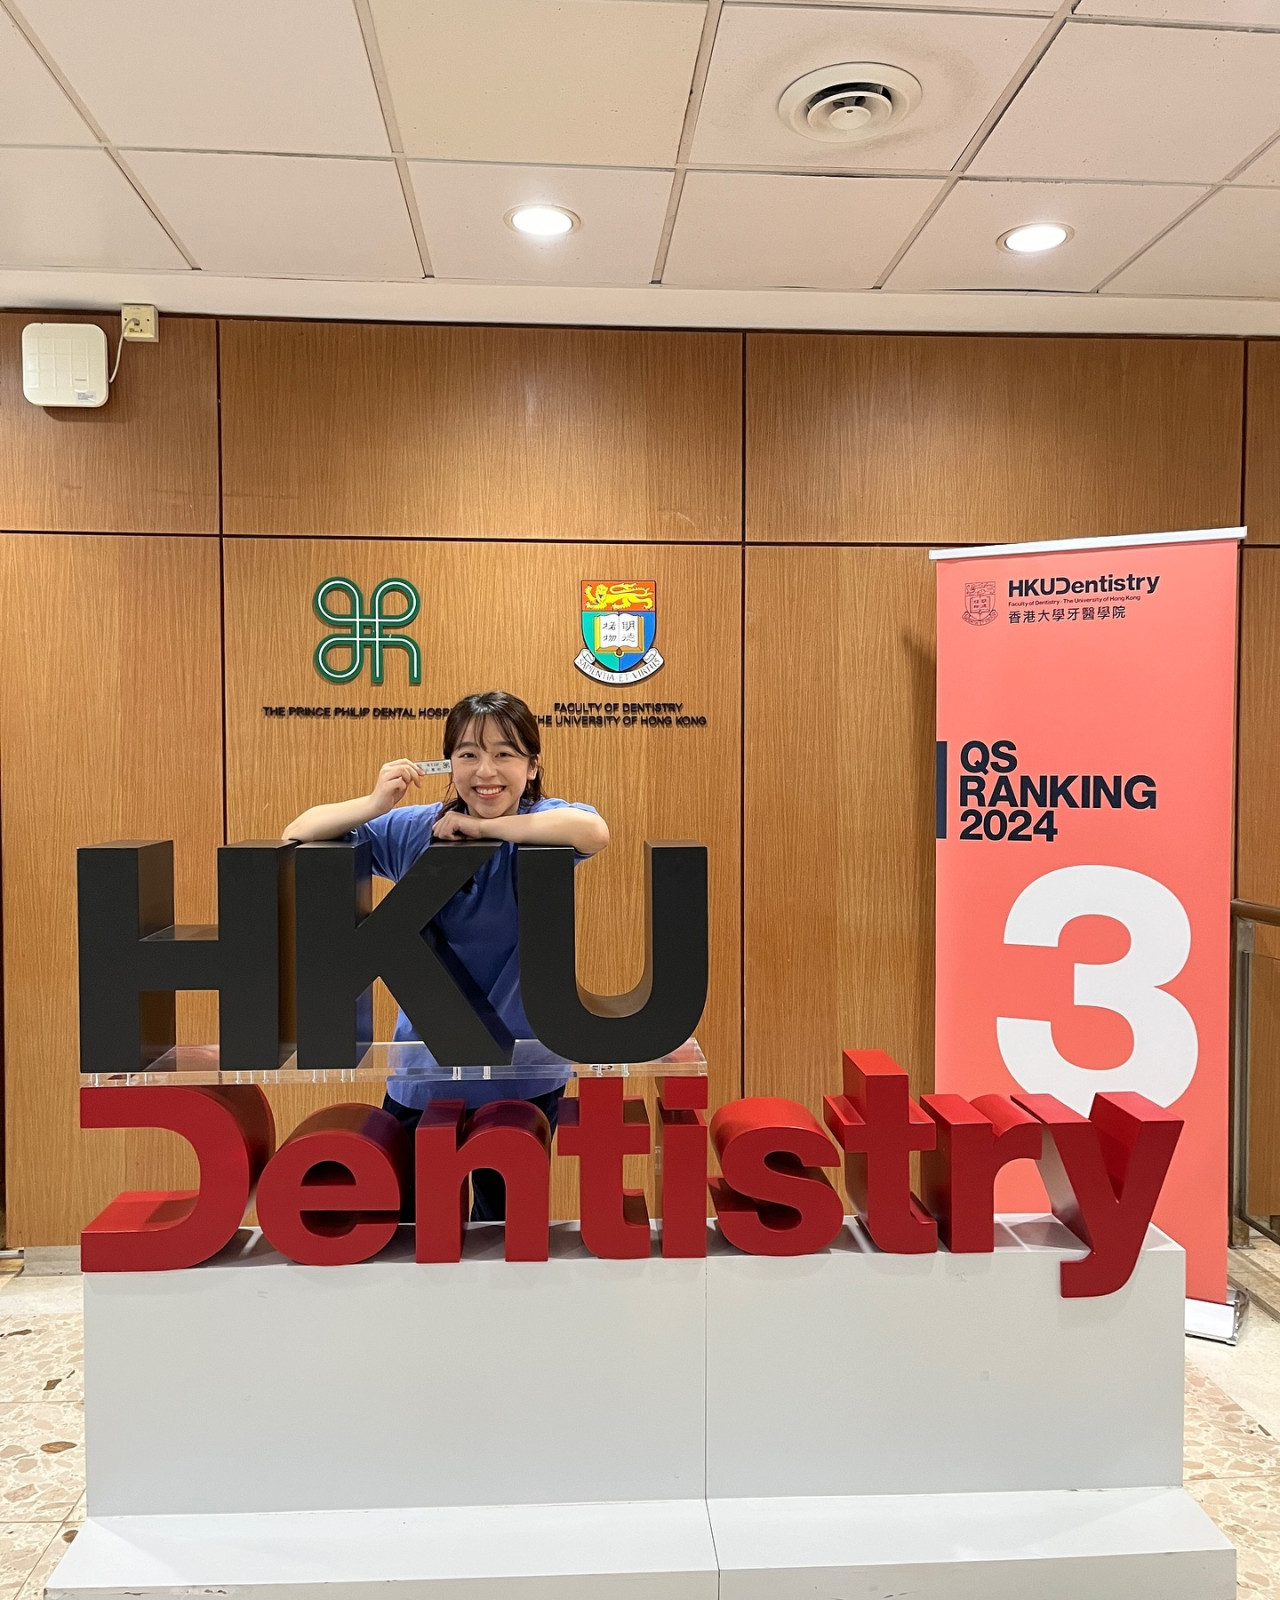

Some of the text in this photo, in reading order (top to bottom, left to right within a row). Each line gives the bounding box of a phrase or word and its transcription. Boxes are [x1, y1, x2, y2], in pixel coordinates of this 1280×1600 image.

[1008, 605, 1126, 624] 香港大學牙醫學院
[262, 706, 286, 718] THE
[288, 706, 331, 718] PRINCE
[334, 707, 370, 718] PHILIP
[373, 707, 416, 718] DENTAL
[554, 702, 683, 714] FACULTY OF DENTISTRY
[556, 715, 621, 727] UNIVERSITY
[622, 715, 637, 727] OF
[641, 715, 672, 727] HONG
[676, 715, 707, 727] KONG
[960, 740, 1018, 775] QS
[959, 775, 1157, 809] RANKING
[959, 809, 1058, 842] 2024
[77, 842, 708, 1073] HKU
[996, 864, 1199, 1119] 3
[79, 1056, 1184, 1298] Dentistry
